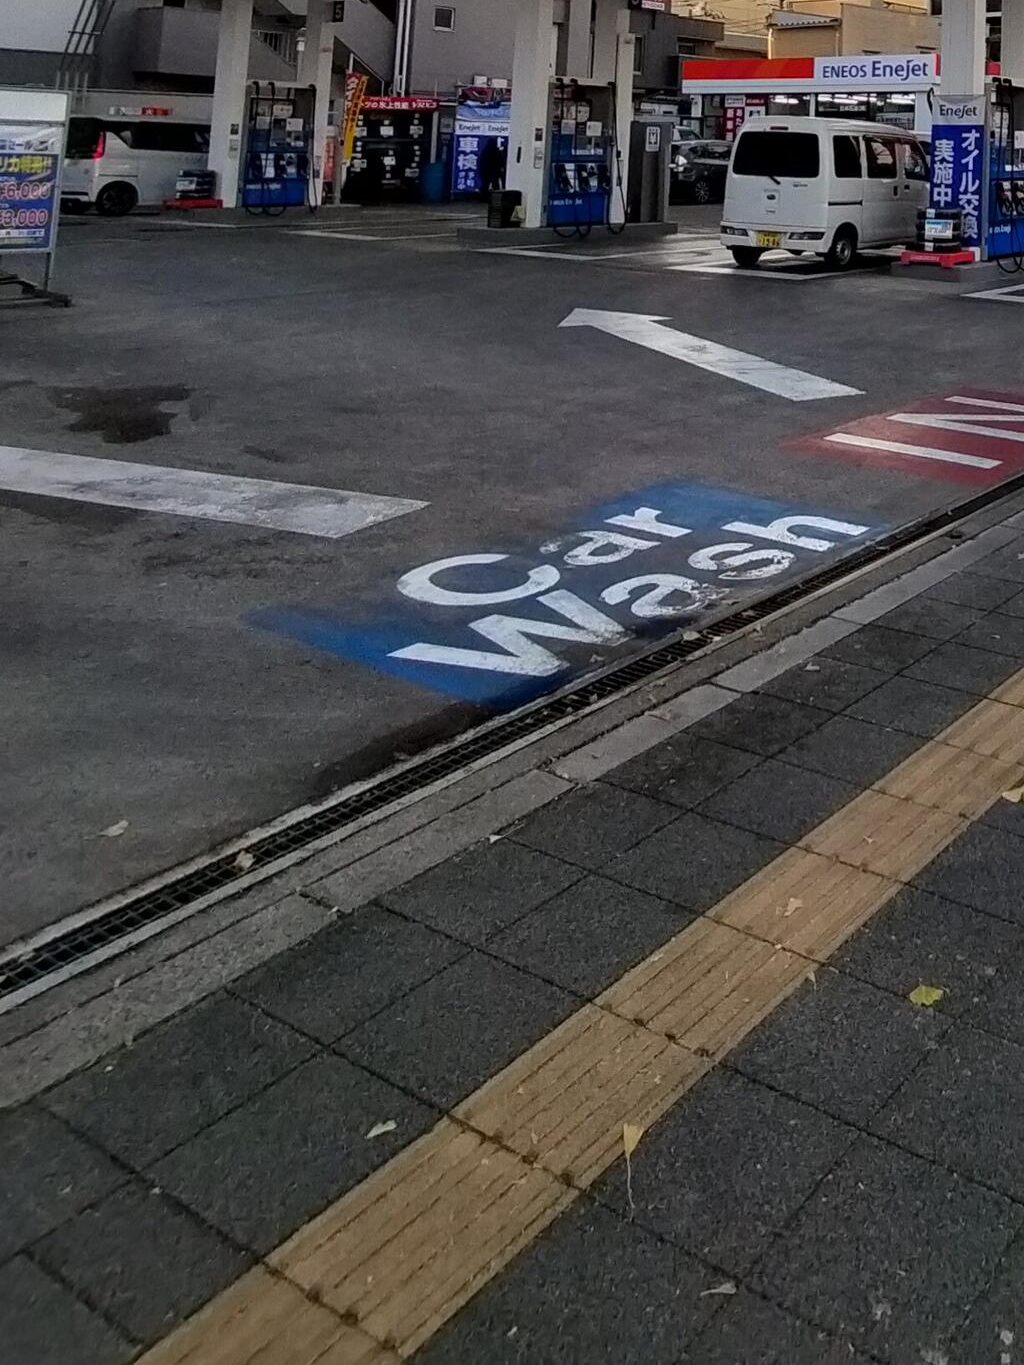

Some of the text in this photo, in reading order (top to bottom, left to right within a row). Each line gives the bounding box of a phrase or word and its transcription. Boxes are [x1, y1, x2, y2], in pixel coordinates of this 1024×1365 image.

[822, 59, 929, 81] ENEOS Enejet
[940, 104, 978, 118] Enejet
[457, 136, 479, 170] 車検
[933, 139, 955, 207] 実施中
[958, 129, 980, 239] オイル交換
[397, 506, 693, 606] Car
[386, 515, 870, 677] Wash
